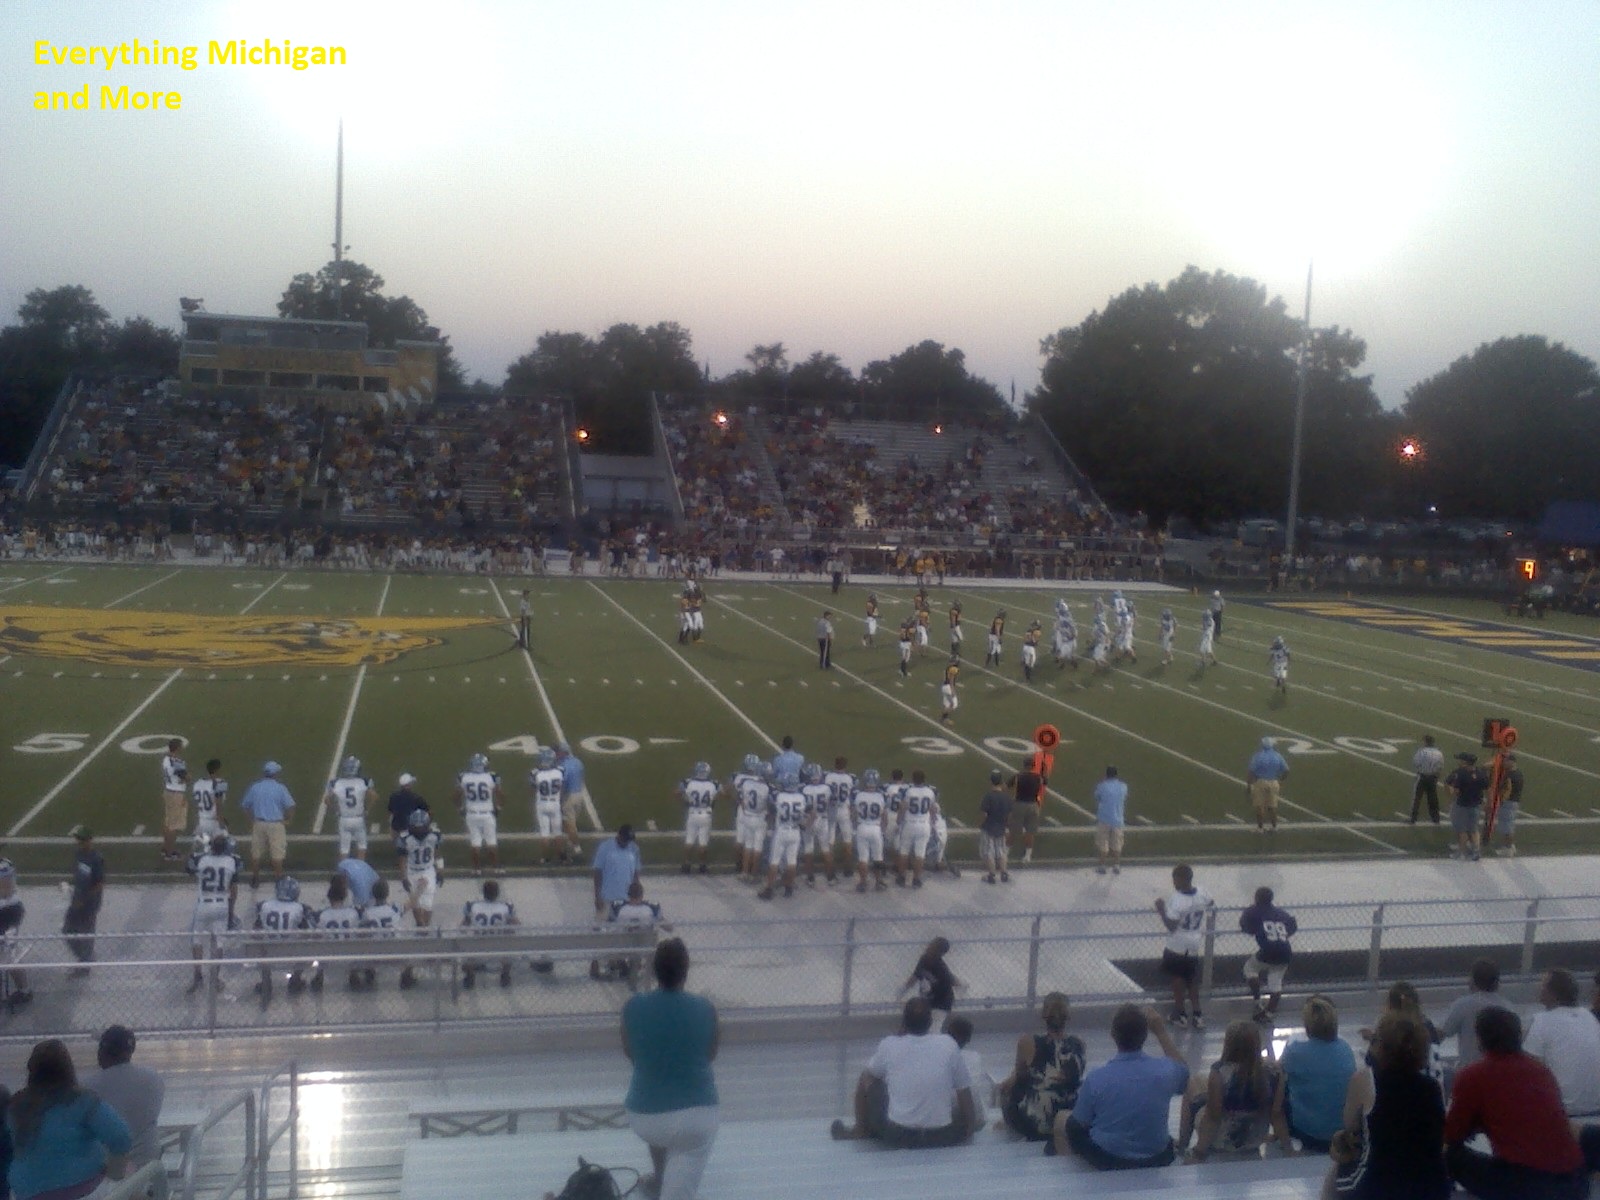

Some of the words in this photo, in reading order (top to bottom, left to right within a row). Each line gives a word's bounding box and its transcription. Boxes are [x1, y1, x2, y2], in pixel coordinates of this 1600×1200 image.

[1524, 560, 1535, 579] 9
[345, 787, 358, 808] 5
[908, 796, 930, 815] 50
[201, 866, 227, 892] 21
